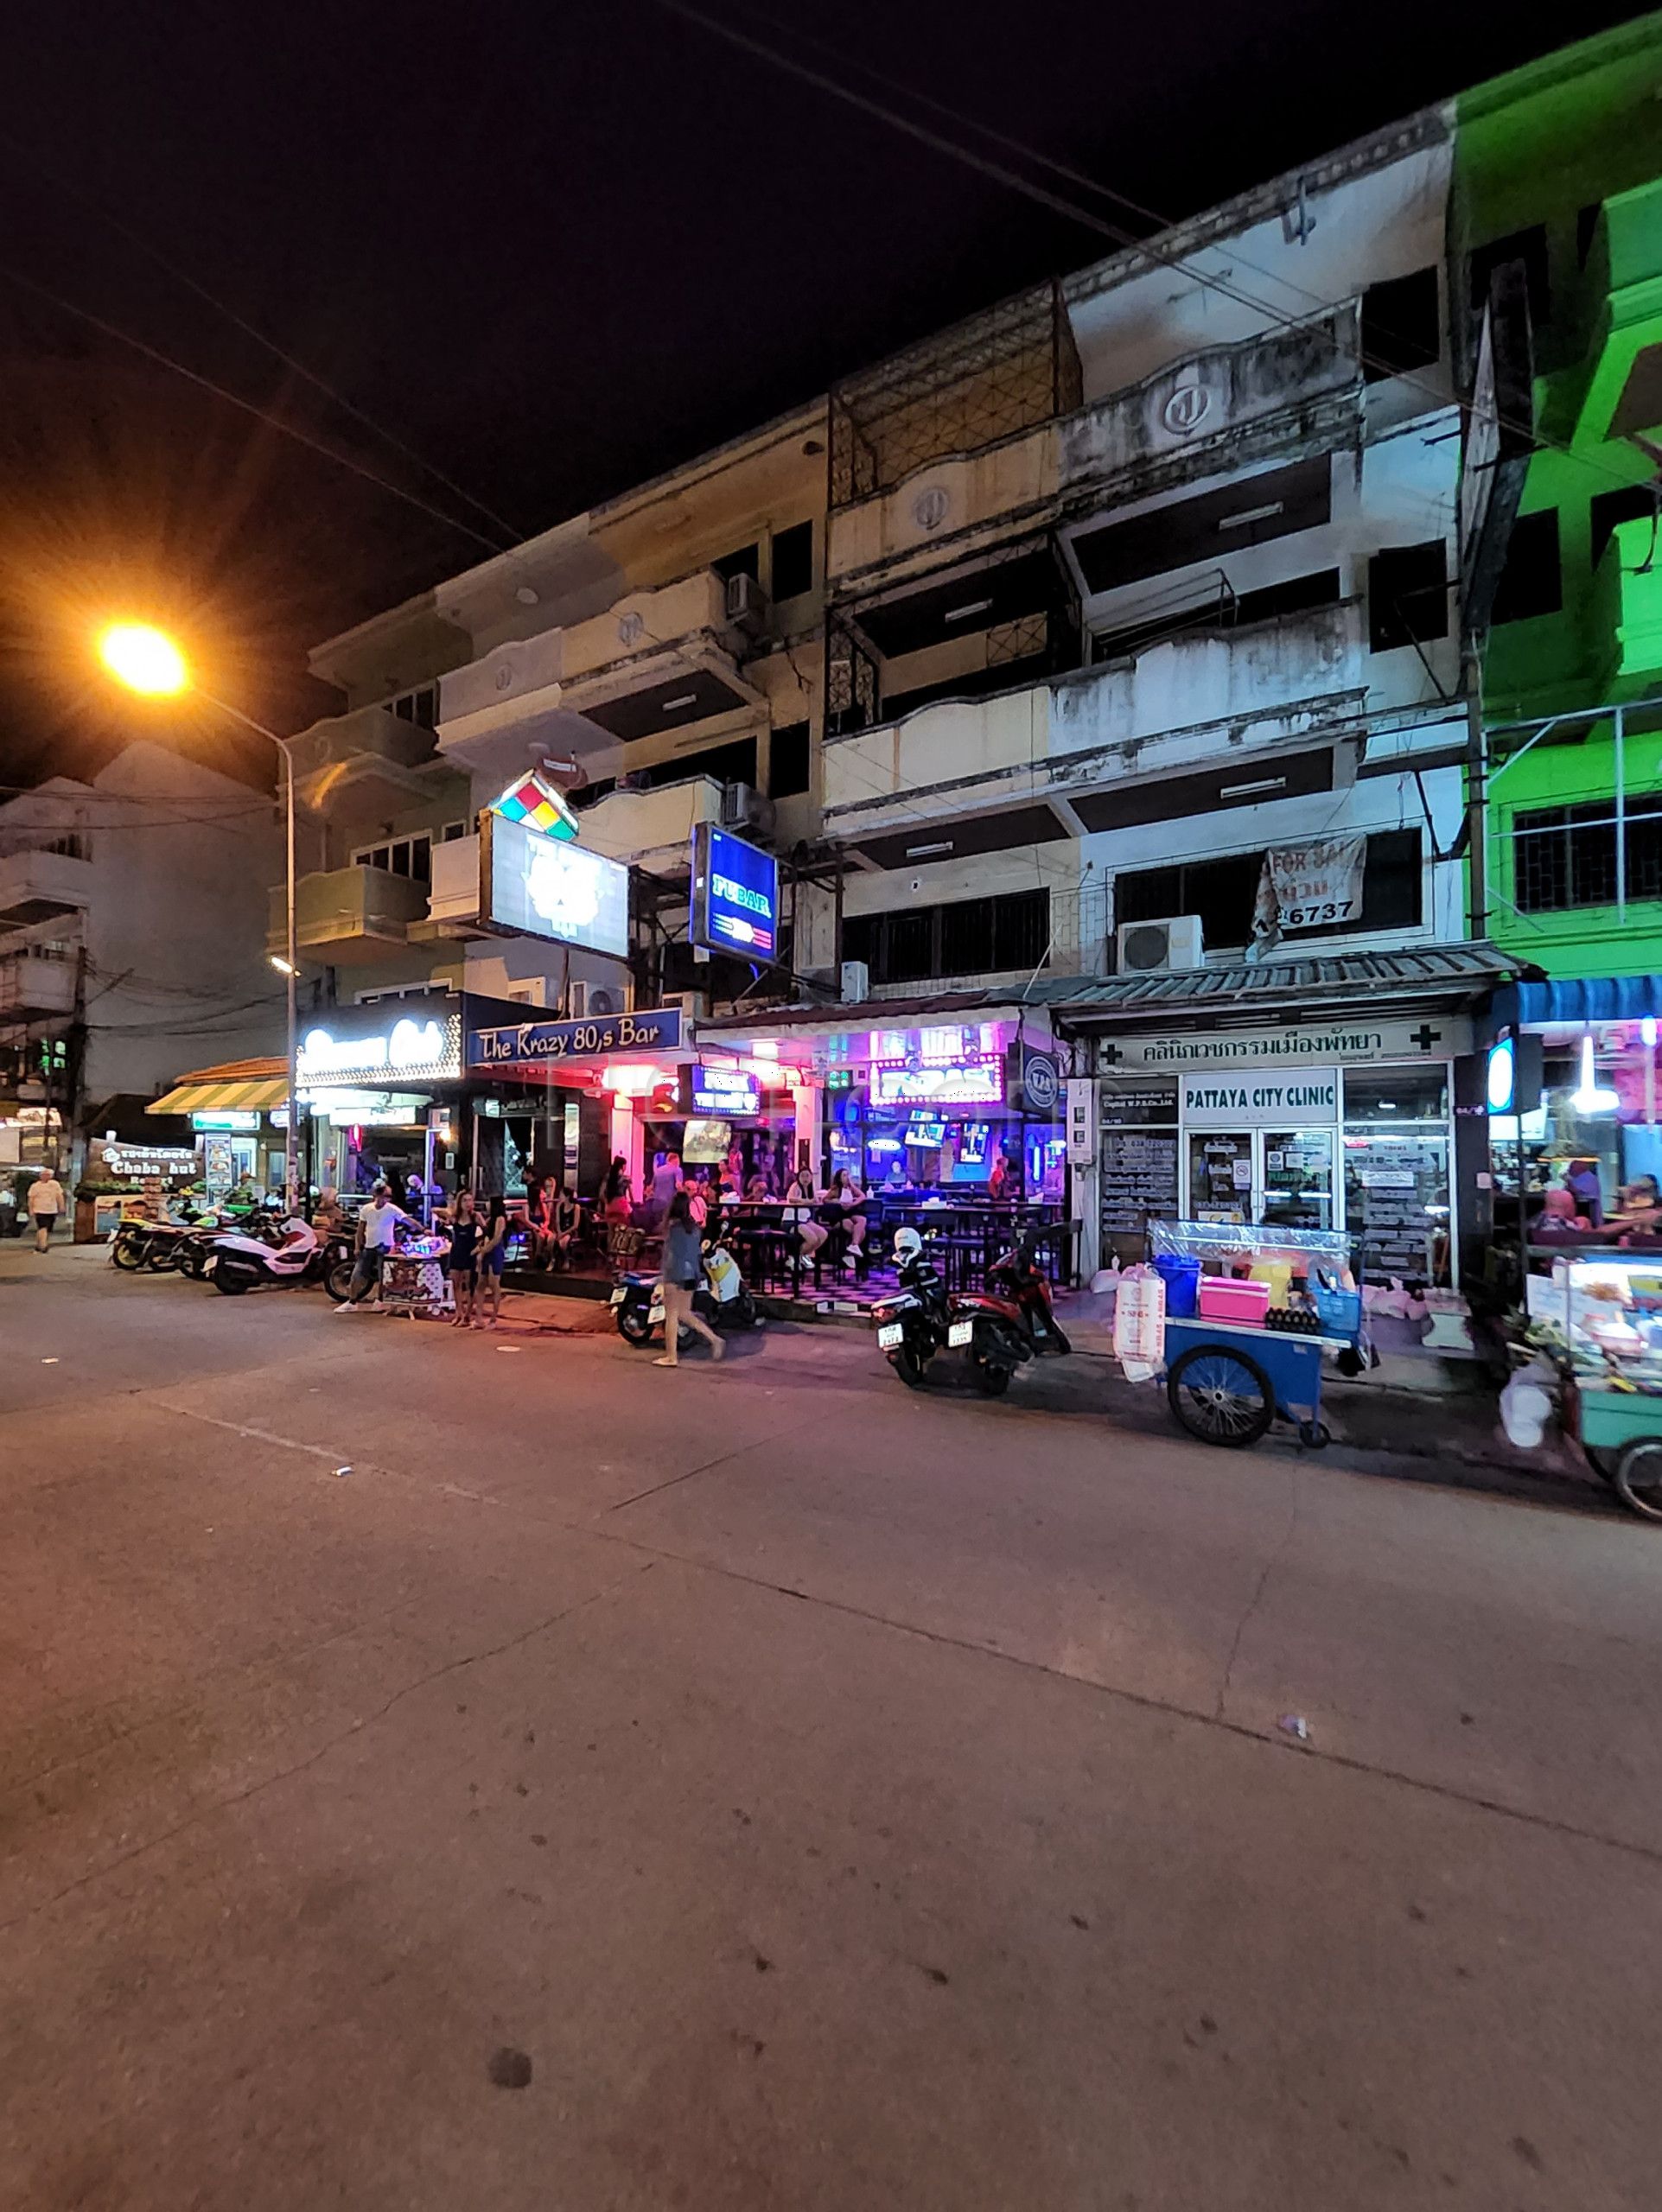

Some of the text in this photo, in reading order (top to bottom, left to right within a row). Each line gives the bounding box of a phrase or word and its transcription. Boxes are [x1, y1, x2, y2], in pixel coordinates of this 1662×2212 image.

[712, 873, 772, 918] FUBAR
[479, 1032, 512, 1059] The
[517, 1026, 569, 1058] Krazy
[618, 1018, 659, 1046] Bar
[1186, 1088, 1247, 1109] PATTAYA
[1252, 1087, 1283, 1108] CITY
[1286, 1085, 1334, 1107] CLINIC
[111, 1161, 197, 1175] Chaba hut
